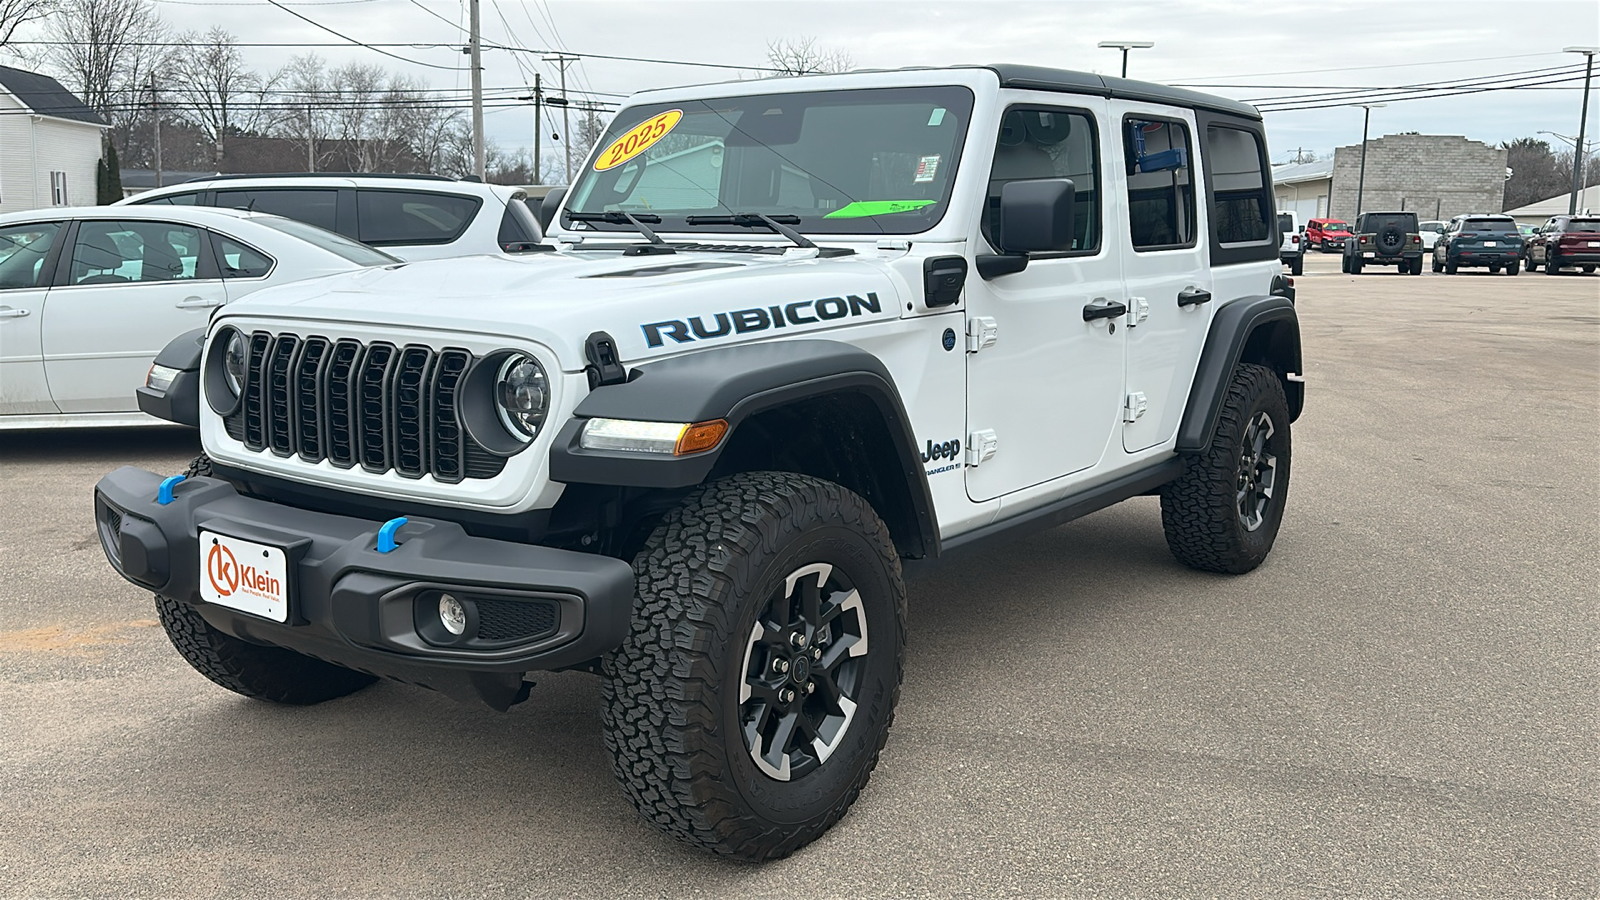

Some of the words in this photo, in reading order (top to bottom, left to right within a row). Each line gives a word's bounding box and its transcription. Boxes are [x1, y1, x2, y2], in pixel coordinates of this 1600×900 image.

[609, 115, 668, 166] 2025
[640, 292, 882, 349] RUBICON
[920, 439, 961, 463] Jeep
[240, 564, 280, 596] Klein
